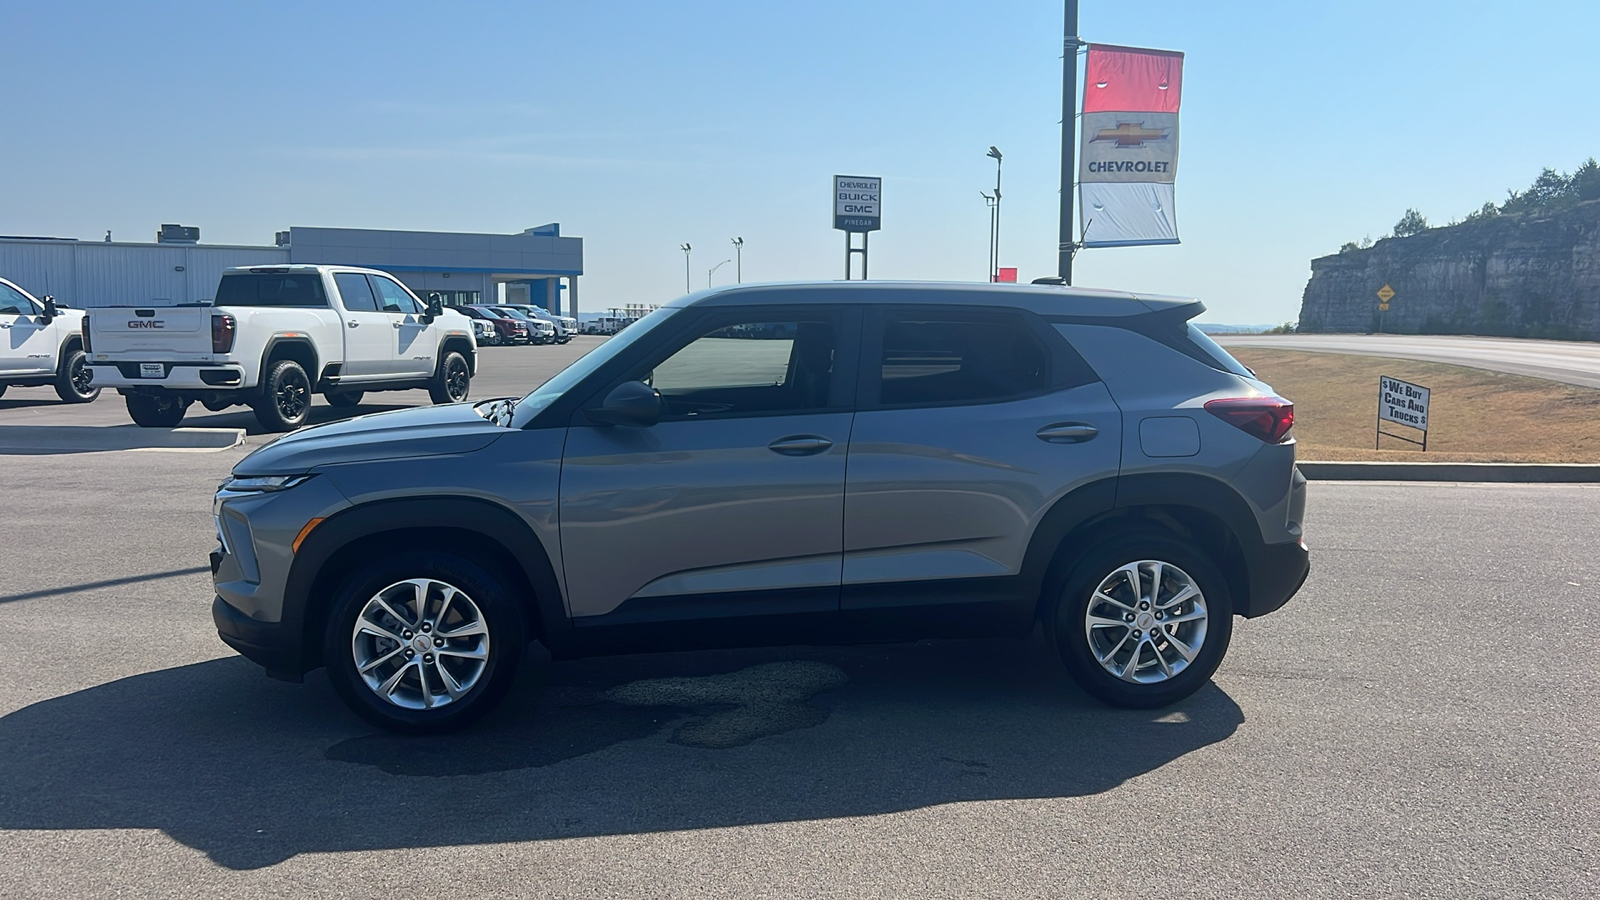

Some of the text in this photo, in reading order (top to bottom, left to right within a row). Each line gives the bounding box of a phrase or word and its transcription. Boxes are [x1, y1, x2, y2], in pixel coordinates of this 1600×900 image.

[1088, 161, 1169, 173] CHEVROLET
[840, 181, 877, 189] CHEVROLET
[839, 193, 877, 201] BUICK
[844, 204, 873, 213] GMC
[127, 320, 165, 329] GMC
